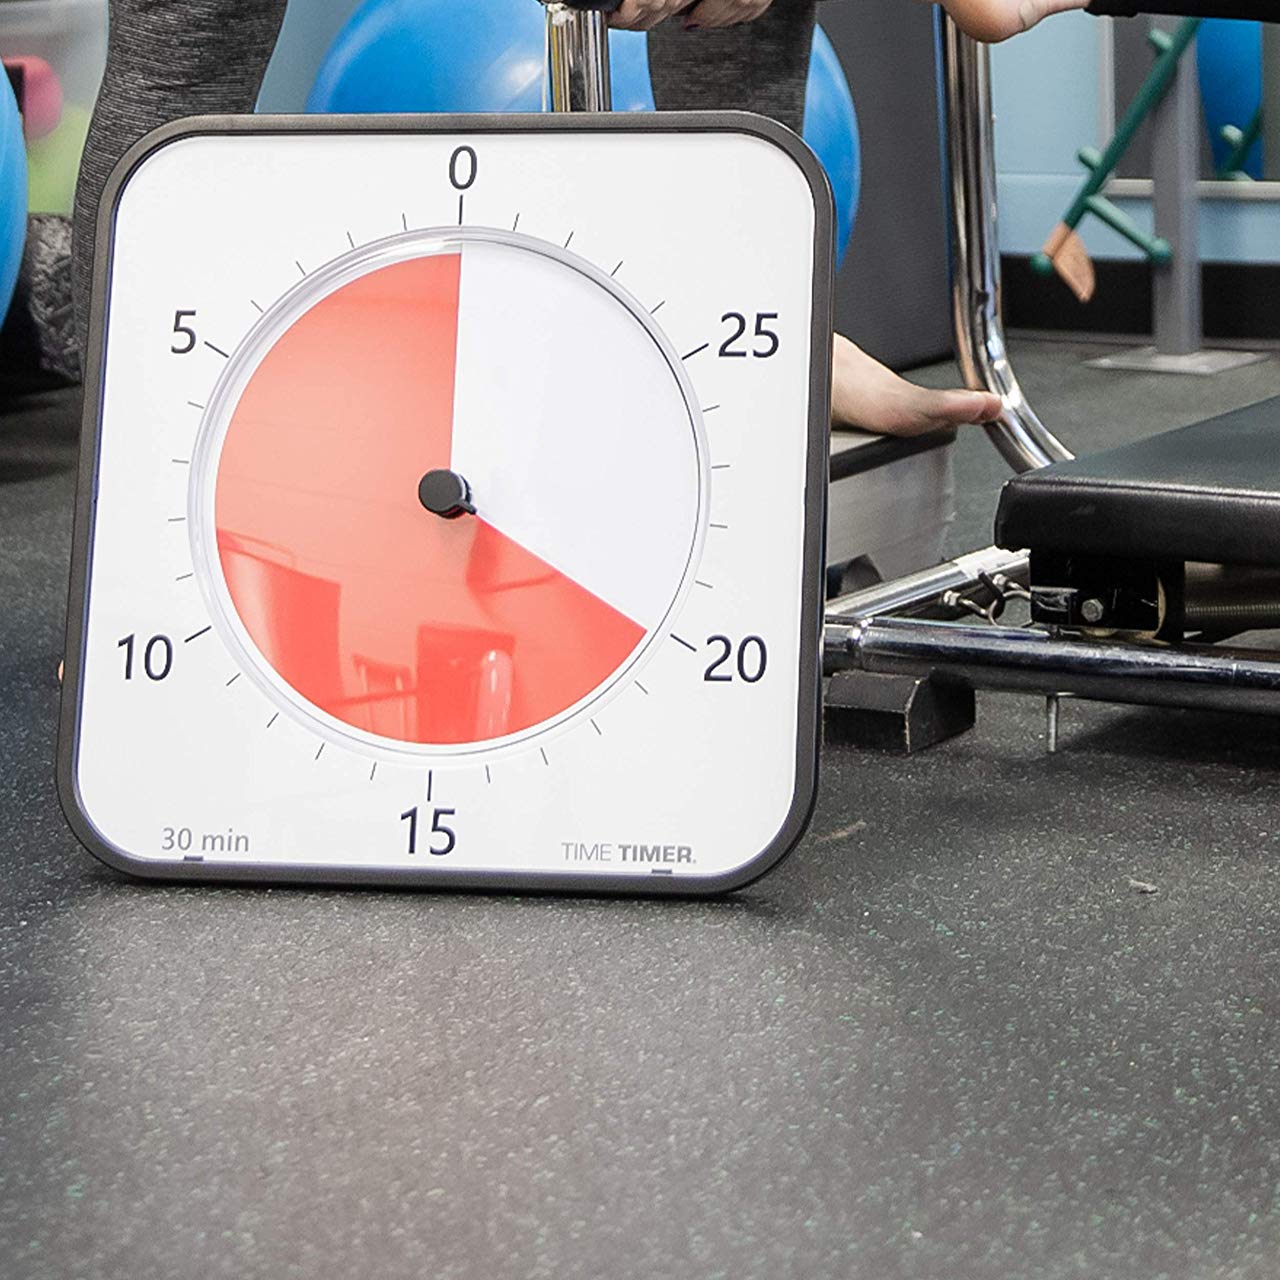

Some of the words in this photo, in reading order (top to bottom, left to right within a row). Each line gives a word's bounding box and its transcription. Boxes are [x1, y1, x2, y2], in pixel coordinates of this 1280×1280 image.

[448, 144, 478, 191] 0
[170, 309, 197, 355] 5
[717, 311, 780, 359] 25
[117, 633, 174, 682] 10
[703, 634, 768, 684] 20
[161, 827, 193, 851] 30
[201, 827, 249, 852] min
[400, 808, 456, 857] 15
[561, 842, 612, 861] TIME
